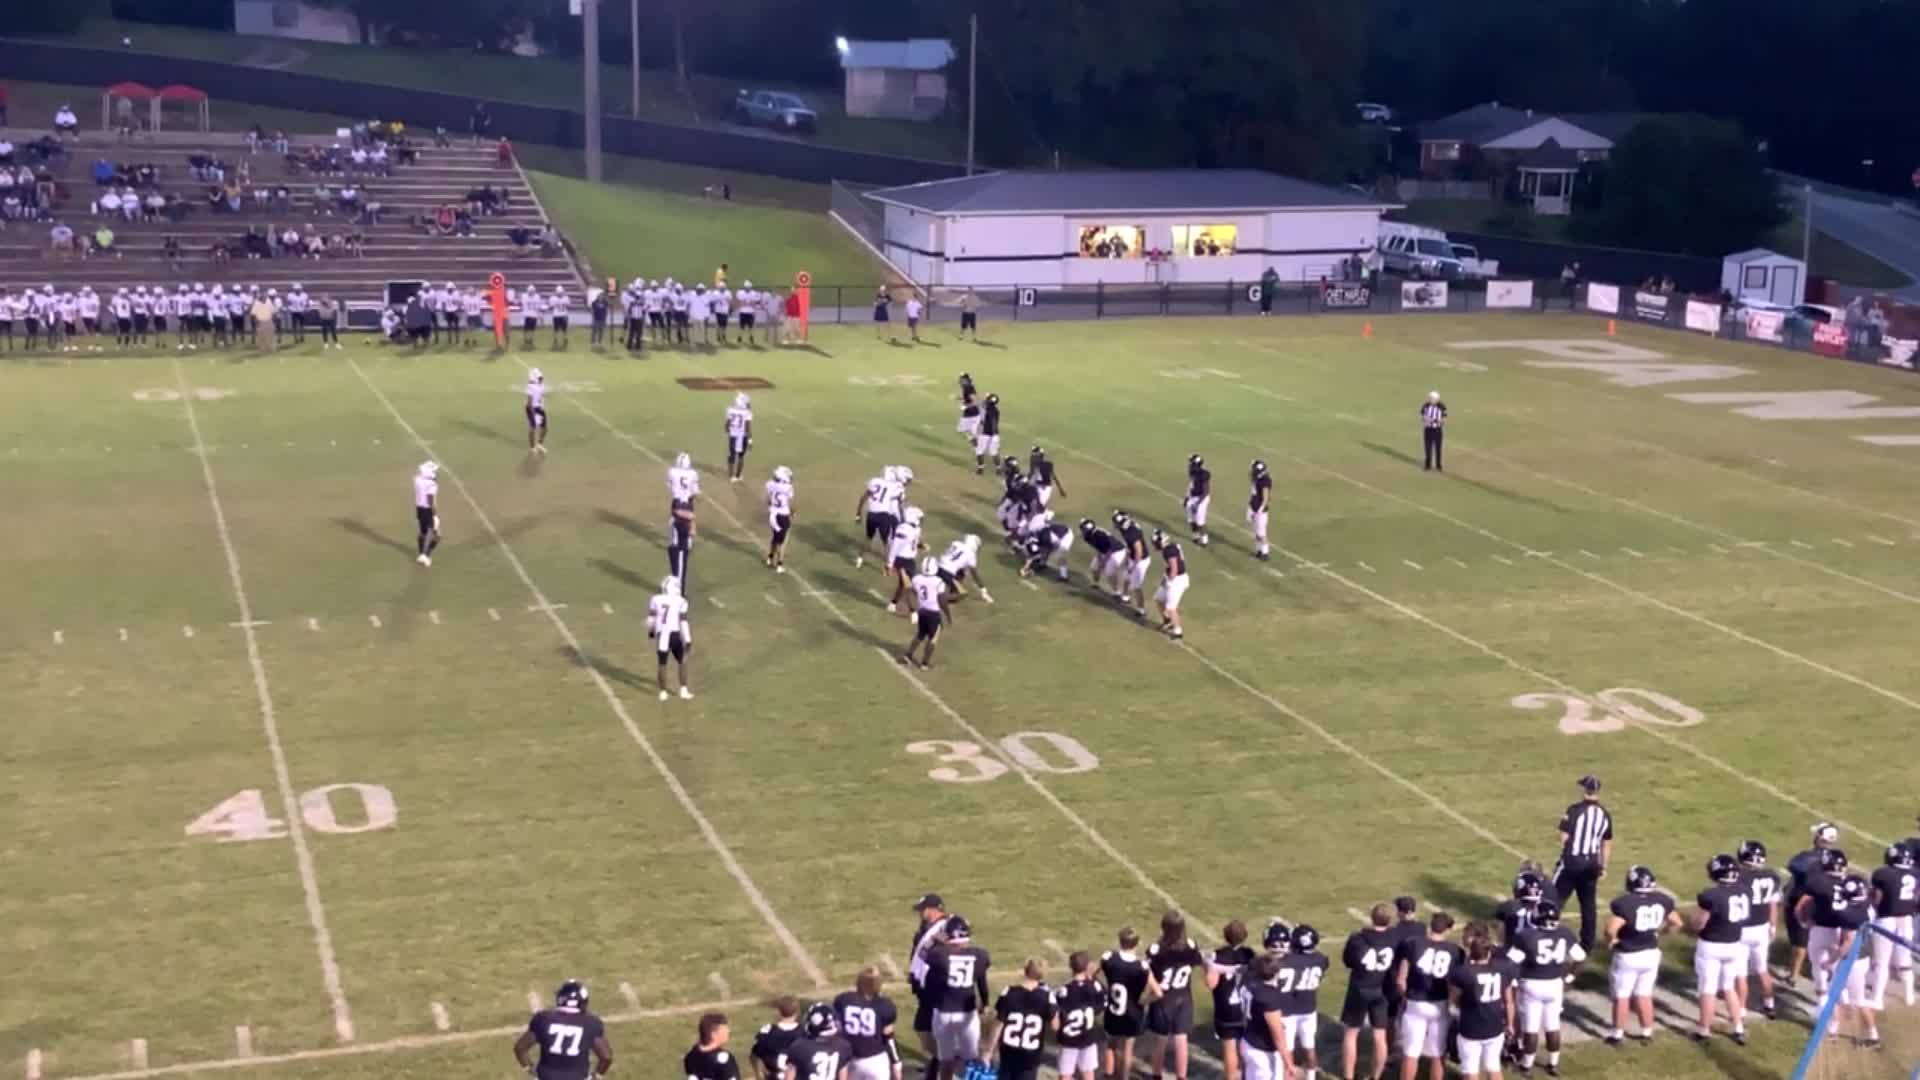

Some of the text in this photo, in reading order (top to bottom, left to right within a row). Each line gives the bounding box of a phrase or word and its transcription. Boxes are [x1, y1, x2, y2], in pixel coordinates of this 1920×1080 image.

[1019, 289, 1034, 305] 10
[661, 603, 671, 625] 7
[1511, 687, 1704, 735] 20
[905, 731, 1100, 783] 30
[184, 782, 399, 842] 40
[1361, 946, 1394, 972] 43
[1417, 947, 1451, 978] 48
[1536, 938, 1567, 965] 54
[948, 955, 976, 988] 51
[1477, 972, 1502, 1003] 71
[844, 1005, 876, 1036] 59
[1003, 1012, 1043, 1051] 22
[1063, 1006, 1094, 1037] 21
[549, 1023, 584, 1056] 77
[809, 1051, 840, 1080] 31
